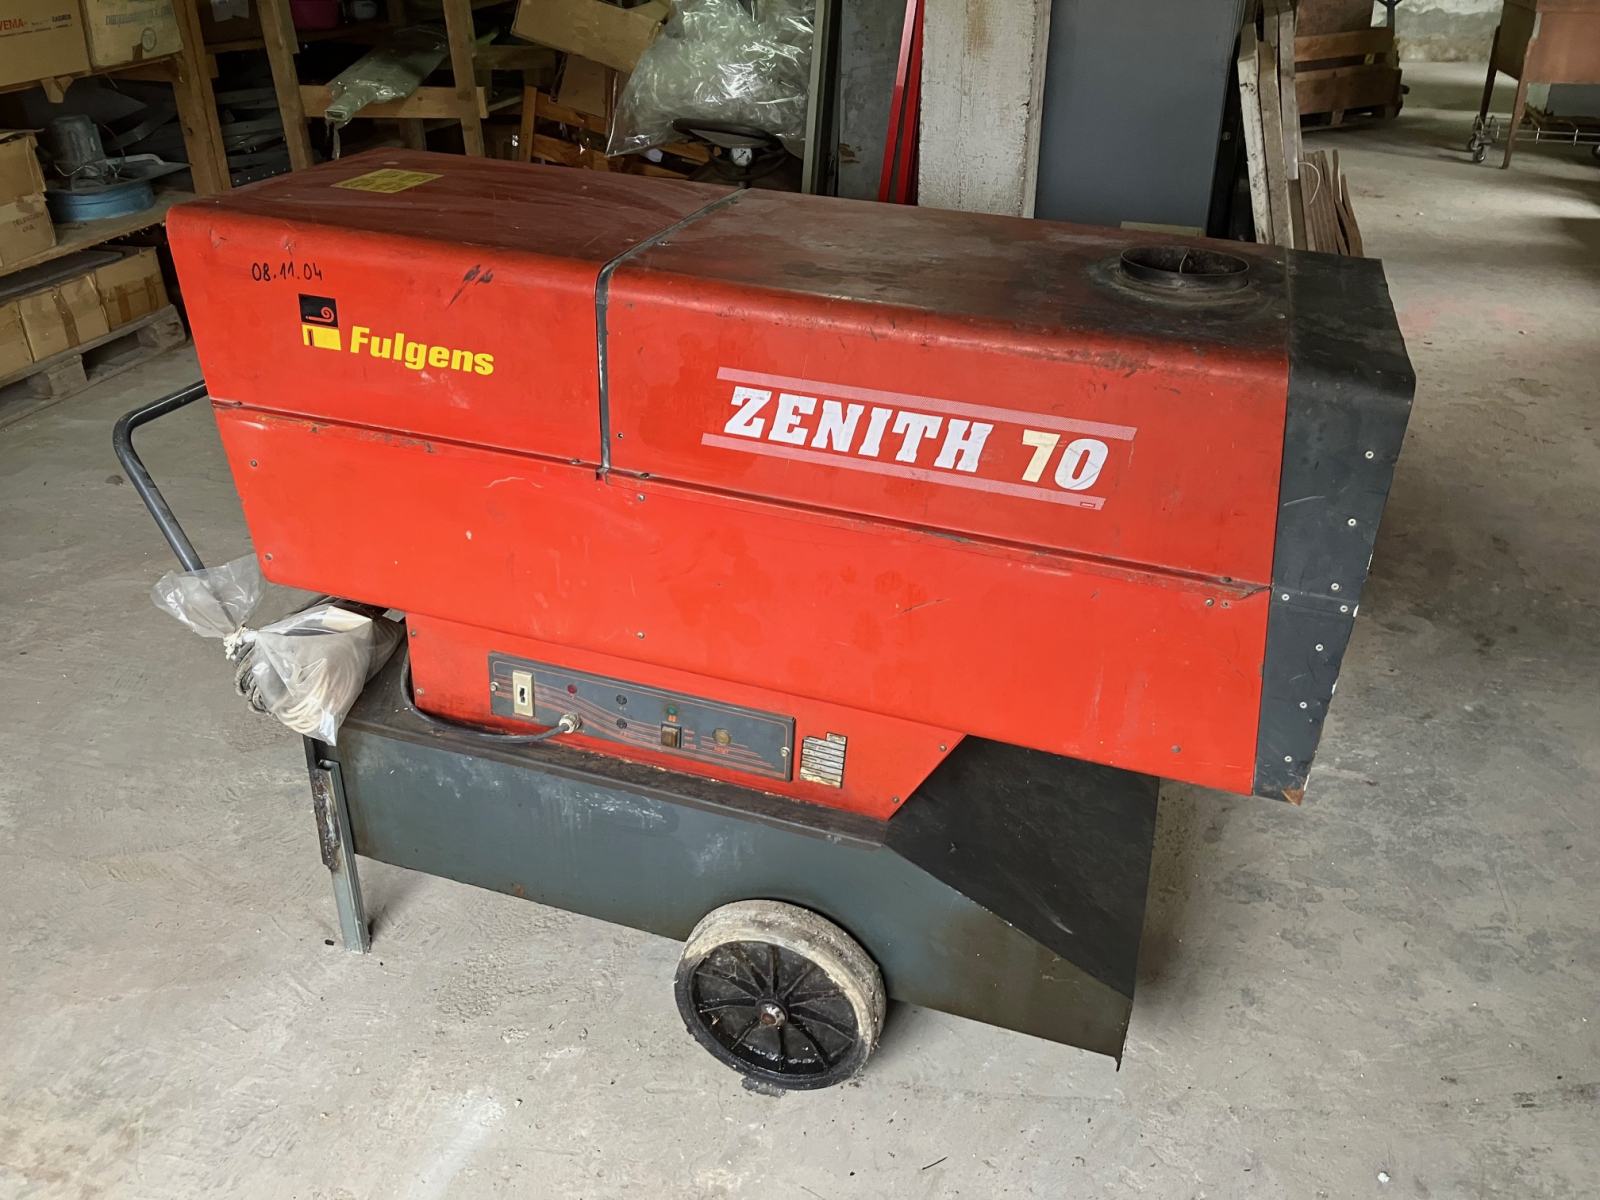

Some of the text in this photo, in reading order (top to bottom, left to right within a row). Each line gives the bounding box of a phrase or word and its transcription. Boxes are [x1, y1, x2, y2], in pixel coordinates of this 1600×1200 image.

[252, 261, 323, 281] 08.11.04
[350, 325, 495, 376] Fulgens
[723, 386, 1109, 491] ZENITH 70
